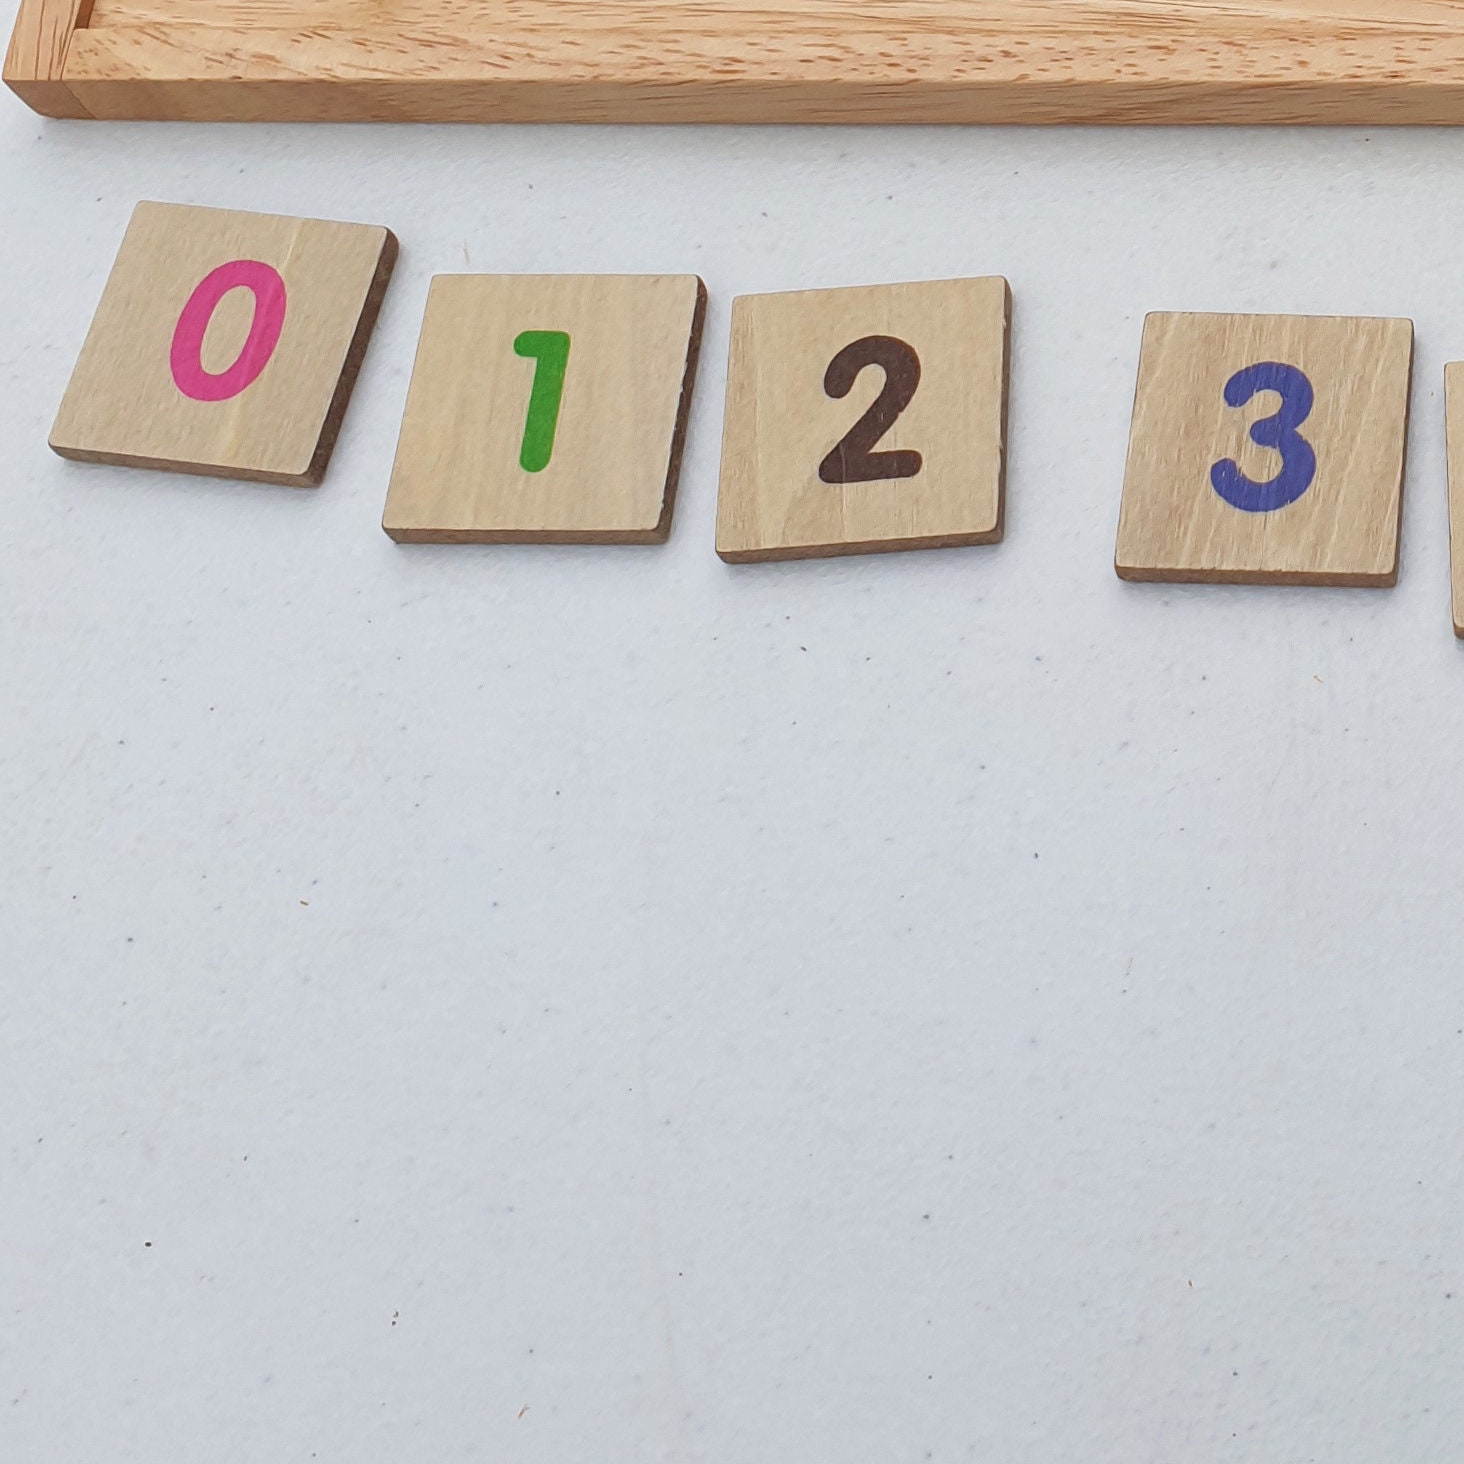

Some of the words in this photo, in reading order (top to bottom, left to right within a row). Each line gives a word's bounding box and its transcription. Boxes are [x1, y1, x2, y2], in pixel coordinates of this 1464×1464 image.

[170, 260, 286, 401] 0
[514, 331, 570, 472] 1
[818, 335, 922, 484] 2
[1210, 362, 1316, 513] 3
